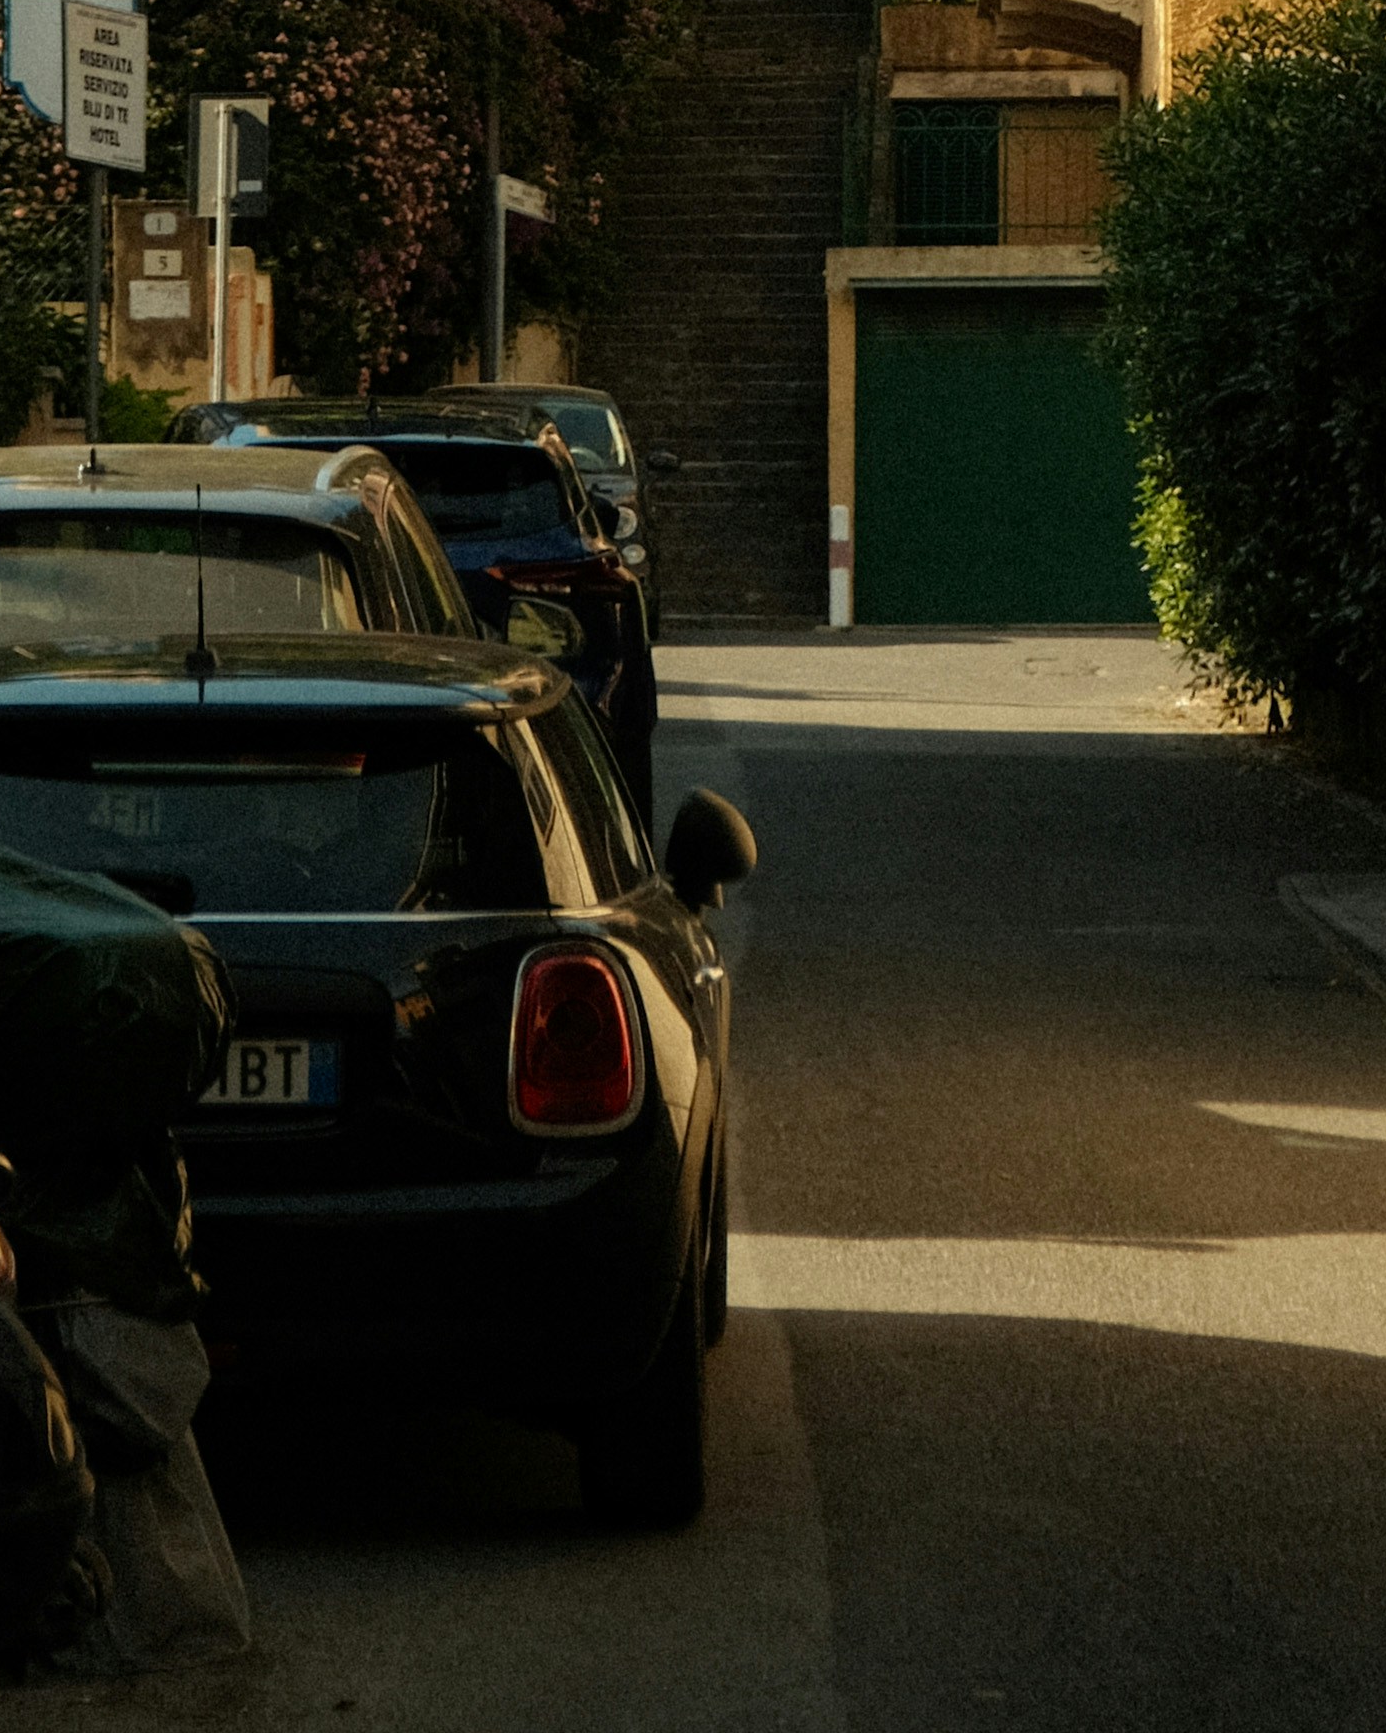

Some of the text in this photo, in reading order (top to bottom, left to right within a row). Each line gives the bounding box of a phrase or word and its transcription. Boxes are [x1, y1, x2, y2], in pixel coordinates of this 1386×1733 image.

[94, 27, 120, 47] AREA
[79, 48, 133, 75] RISERVATA
[84, 74, 129, 100] SERVIZIO
[83, 99, 129, 125] BLU DI TE
[90, 126, 121, 148] HOTEL
[159, 255, 169, 272] 5
